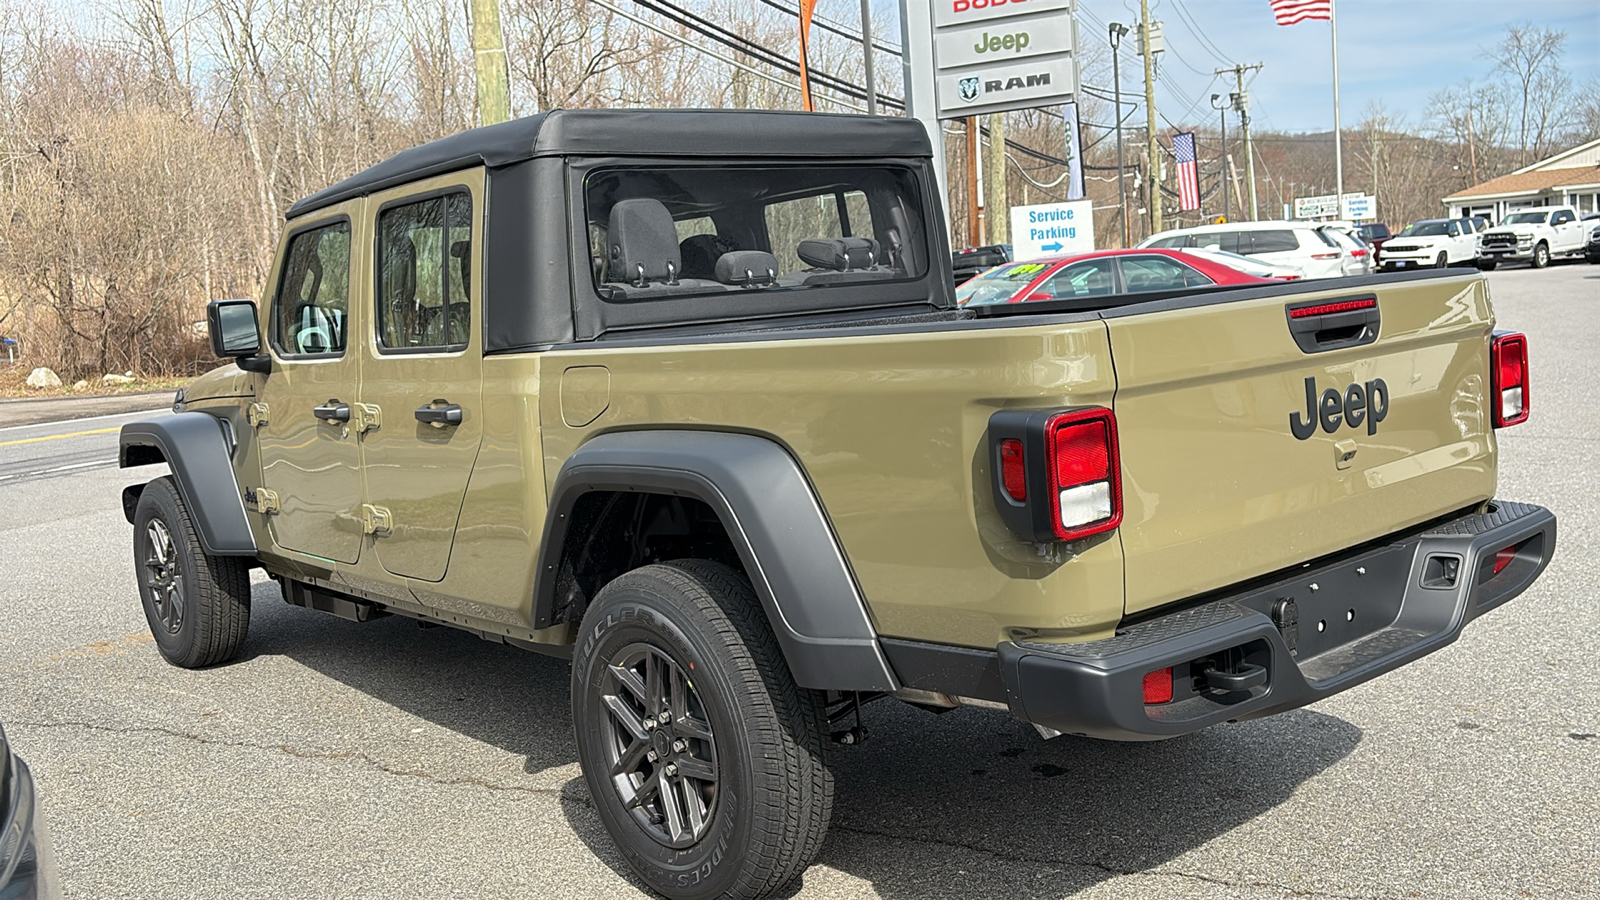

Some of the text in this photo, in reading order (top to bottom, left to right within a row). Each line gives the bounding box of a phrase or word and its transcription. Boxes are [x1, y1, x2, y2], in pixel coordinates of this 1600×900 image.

[974, 32, 1030, 54] Jeep
[985, 73, 1051, 93] RAM
[1029, 204, 1074, 223] Service
[1030, 226, 1076, 240] Parking
[1289, 376, 1389, 440] Jeep
